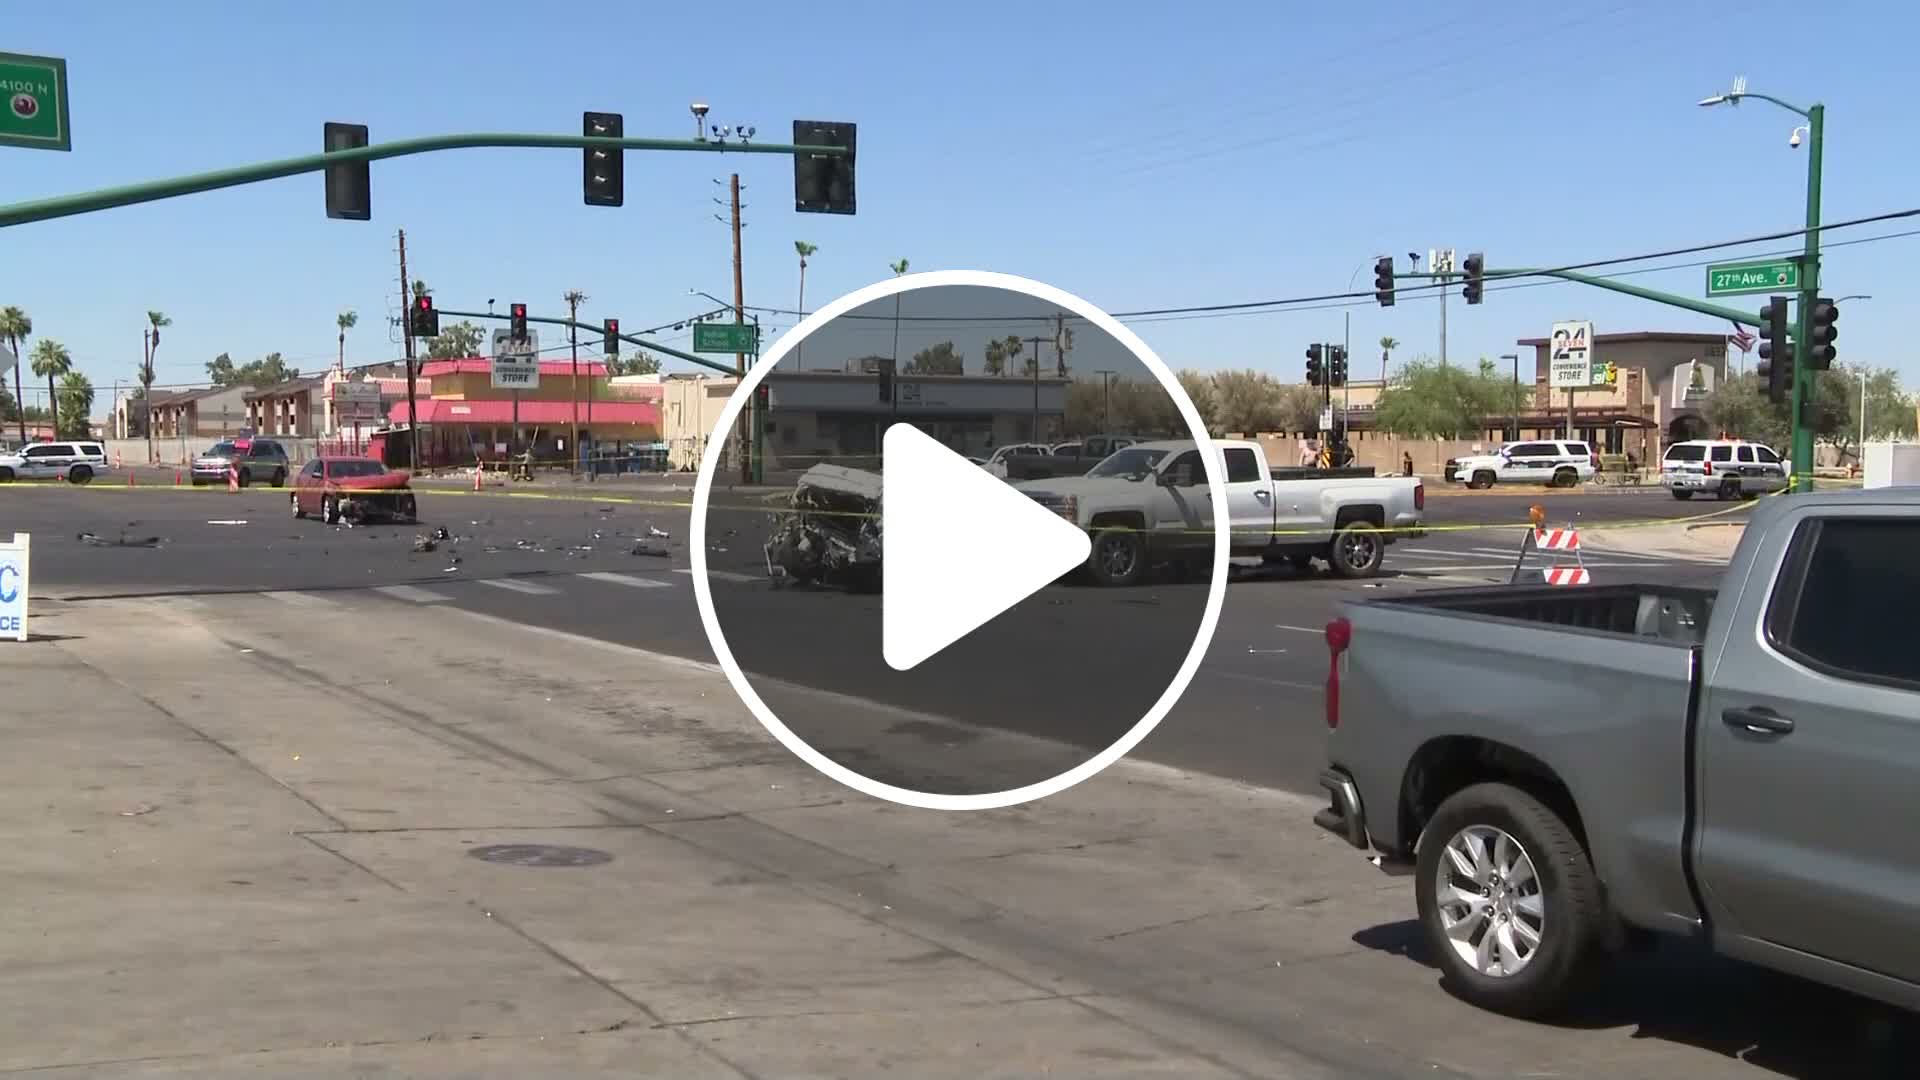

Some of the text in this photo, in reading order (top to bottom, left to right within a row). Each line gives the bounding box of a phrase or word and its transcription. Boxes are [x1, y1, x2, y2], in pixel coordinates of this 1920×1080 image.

[0, 80, 48, 96] 4100 N
[1716, 272, 1768, 287] 27th Ave.
[1553, 328, 1587, 360] 24
[502, 374, 529, 383] STORE
[1558, 370, 1582, 380] STORE
